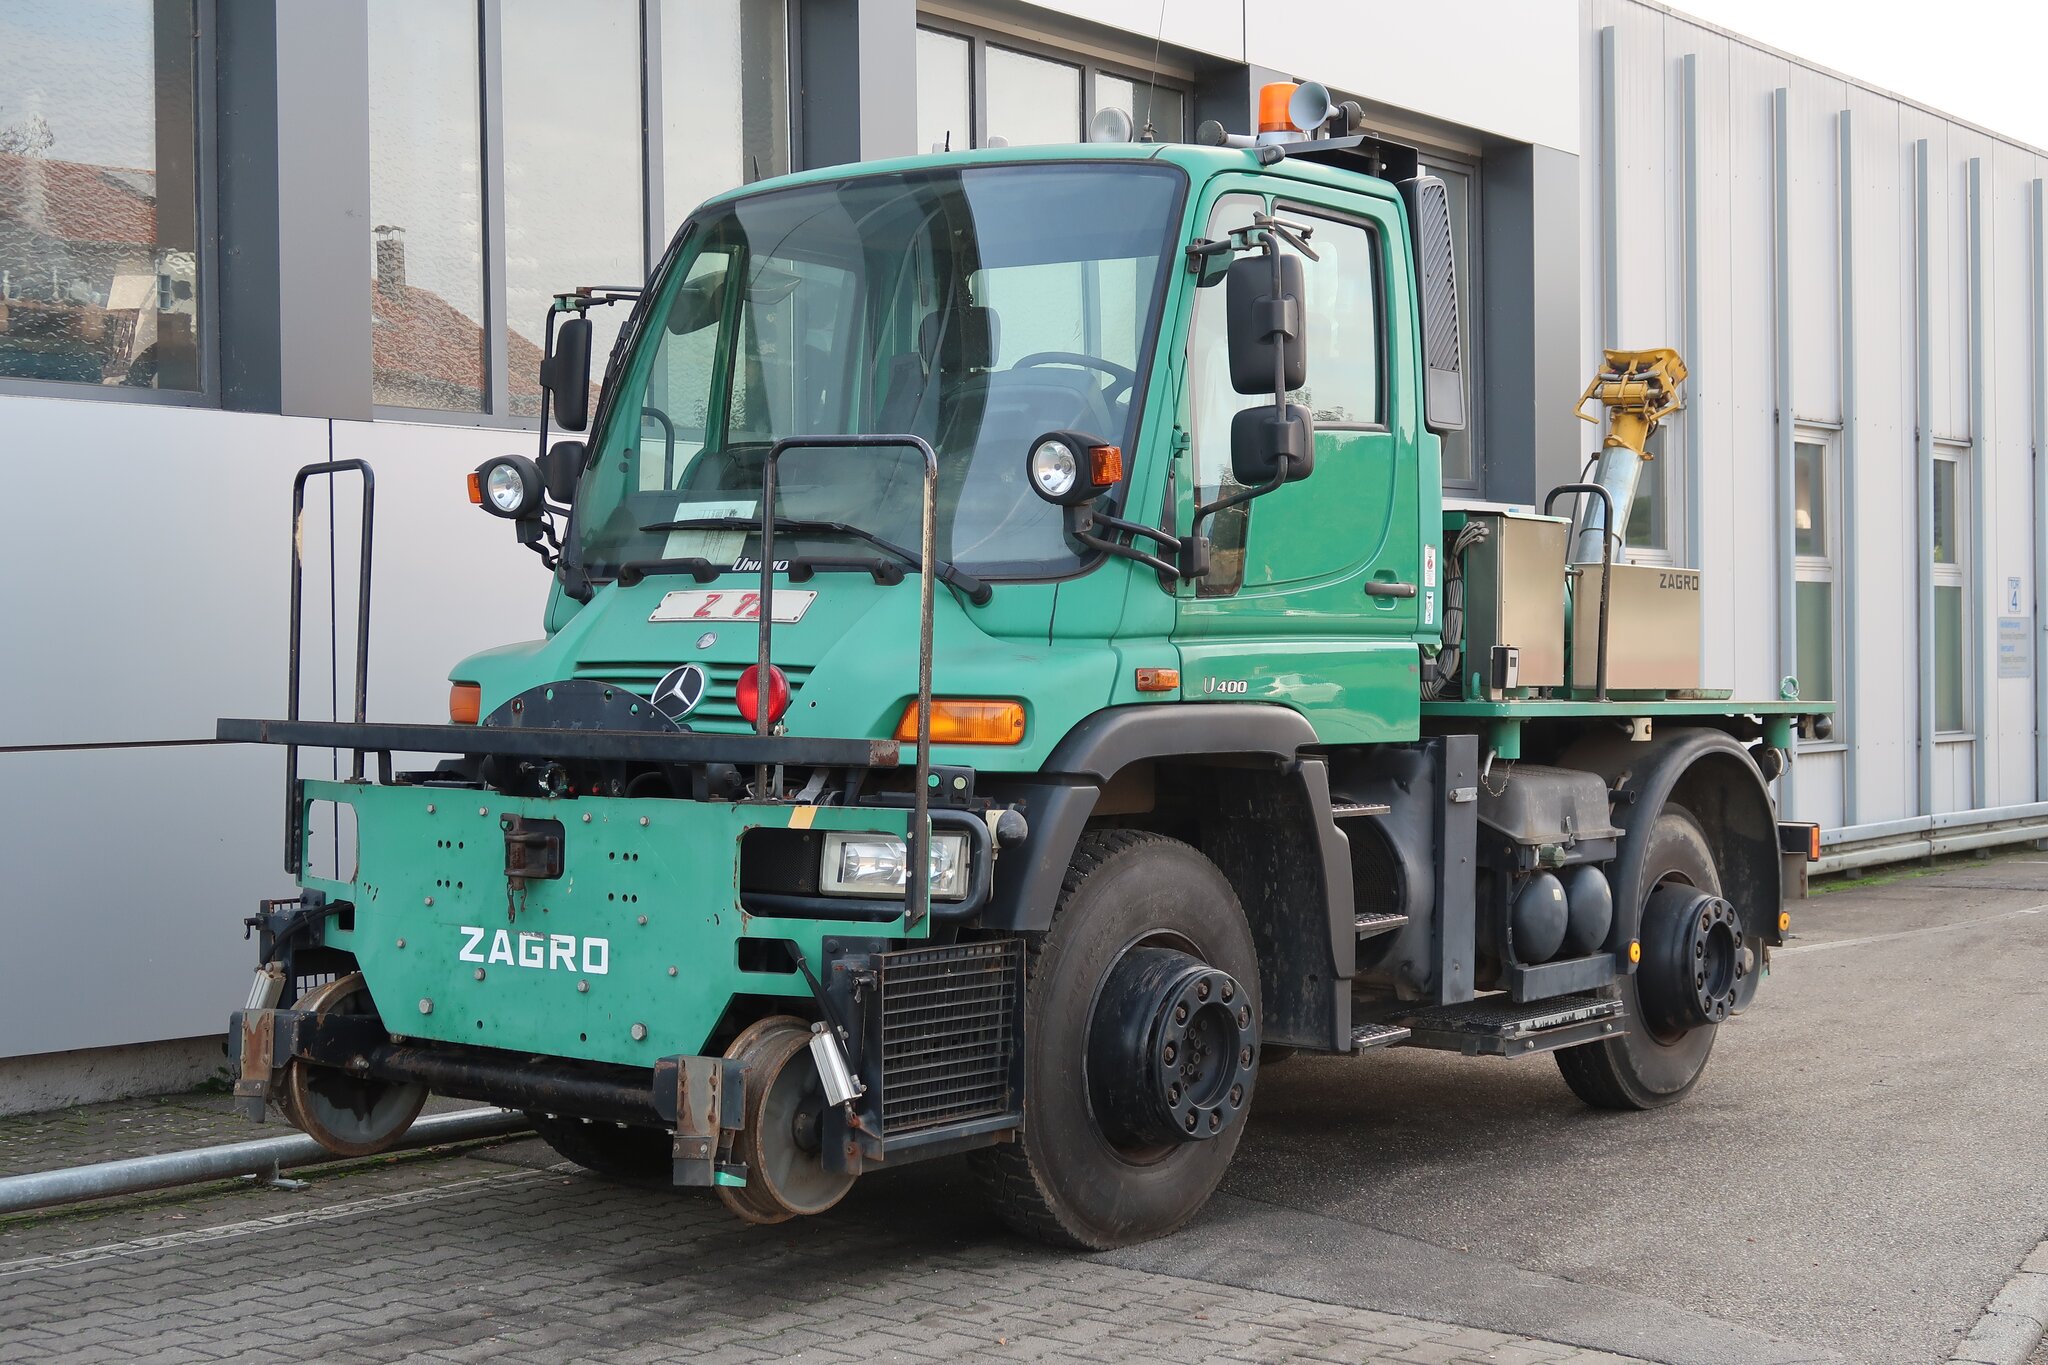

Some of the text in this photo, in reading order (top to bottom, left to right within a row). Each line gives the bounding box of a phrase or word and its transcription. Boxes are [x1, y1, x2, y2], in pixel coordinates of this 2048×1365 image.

[1659, 573, 1699, 591] ZAGRO
[694, 594, 723, 617] Z
[2011, 590, 2018, 610] 4
[1204, 677, 1248, 694] U 400
[459, 926, 609, 974] ZAGRO
